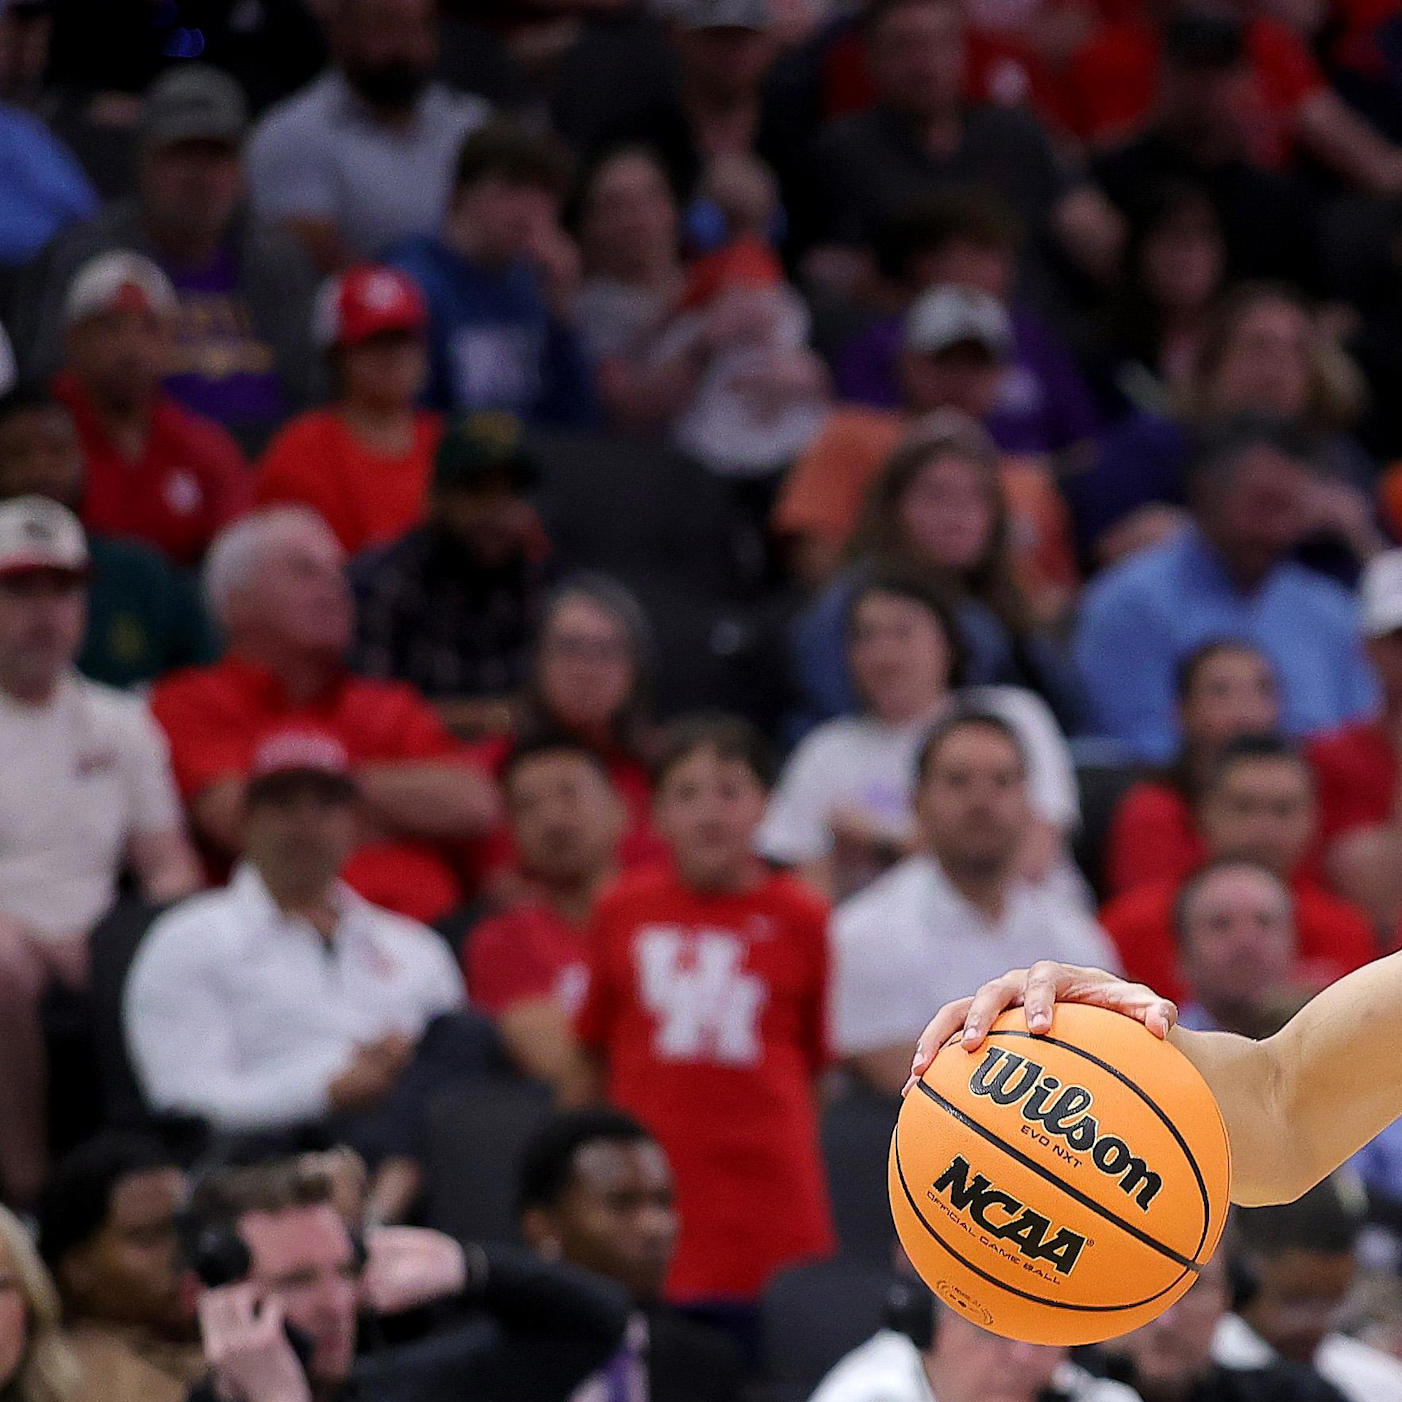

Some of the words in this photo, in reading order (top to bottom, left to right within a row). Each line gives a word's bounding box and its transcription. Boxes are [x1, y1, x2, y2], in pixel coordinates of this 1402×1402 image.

[968, 1046, 1163, 1213] Wilson
[1020, 1124, 1050, 1147] EVO
[1052, 1145, 1083, 1169] NXT
[926, 1190, 977, 1238] OFFICIAL
[979, 1235, 1022, 1266] GAME
[1023, 1262, 1061, 1286] BALL
[932, 1154, 1088, 1277] NCAA
